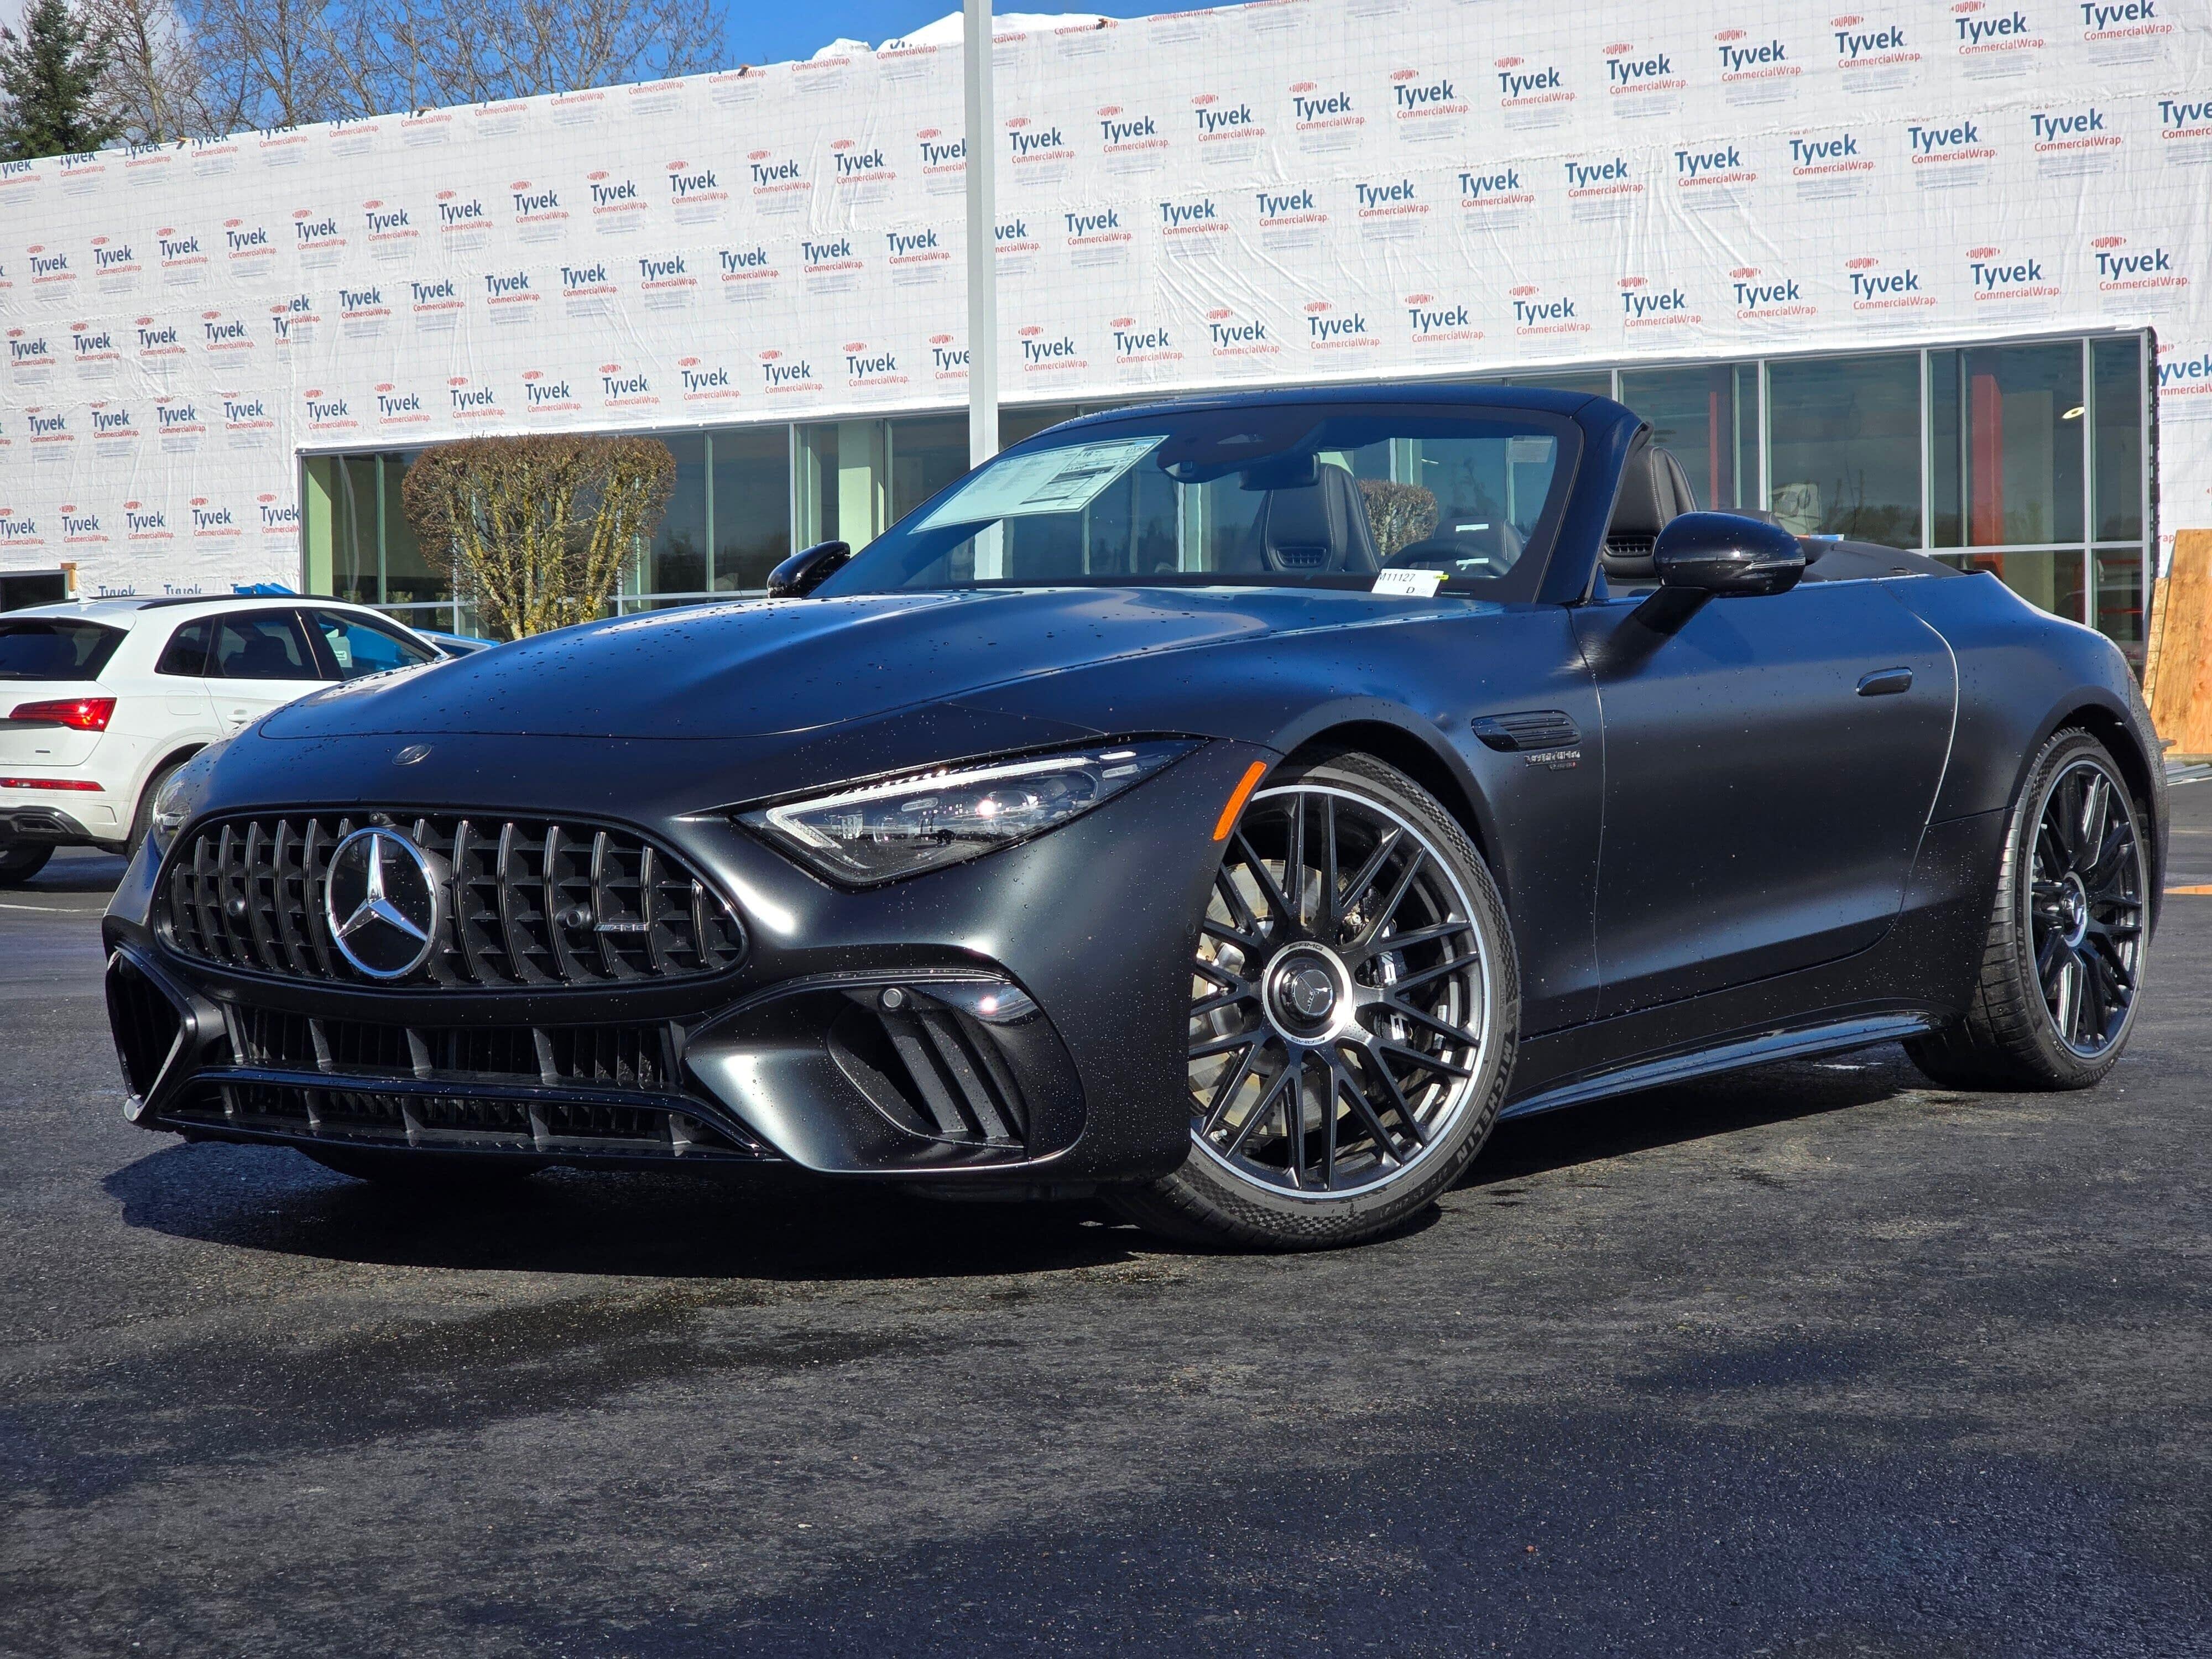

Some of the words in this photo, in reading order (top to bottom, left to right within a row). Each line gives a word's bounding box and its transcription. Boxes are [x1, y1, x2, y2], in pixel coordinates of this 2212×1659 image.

[2081, 0, 2154, 30] Tyvek
[1955, 12, 2026, 44] Tyvek
[1835, 26, 1903, 58] Tyvek
[1719, 40, 1785, 71] Tyvek
[1499, 67, 1560, 97] Tyvek
[1607, 54, 1670, 85] Tyvek
[1293, 92, 1350, 121] Tyvek
[1394, 80, 1453, 109] Tyvek
[1196, 104, 1251, 132] Tyvek
[2031, 108, 2103, 141] Tyvek
[2158, 101, 2212, 128] Tyve
[1010, 128, 1062, 154] Tyvek
[1101, 116, 1155, 143] Tyvek
[1908, 122, 1978, 153] Tyvek
[834, 150, 883, 174] Tyvek
[1675, 146, 1740, 176] Tyvek
[1790, 134, 1856, 165] Tyvek
[1, 160, 32, 179] yvek
[751, 160, 799, 185] Tyvek
[1565, 158, 1627, 187] Tyvek
[591, 181, 635, 205] Tyvek
[670, 171, 716, 196] Tyvek
[1356, 180, 1414, 207] Tyvek
[1459, 169, 1519, 198] Tyvek
[440, 201, 482, 223] Tyvek
[514, 191, 560, 215] Tyvek
[1160, 199, 1215, 226] Tyvek
[1256, 190, 1313, 217] Tyvek
[296, 218, 336, 241] Tyvek
[367, 210, 410, 232] Tyvek
[995, 220, 1026, 239] vek
[1065, 209, 1118, 236] Tyvek
[160, 237, 199, 258] Tyvek
[228, 228, 266, 249] Tyvek
[886, 229, 937, 255] Tyvek
[96, 248, 132, 267] Tyvek
[719, 247, 766, 272] Tyvek
[802, 239, 850, 264] Tyvek
[32, 256, 66, 274] Tyvek
[561, 264, 606, 288] Tyvek
[639, 256, 685, 280] Tyvek
[1971, 259, 2041, 290] Tyvek
[2096, 249, 2169, 280] Tyvek
[412, 280, 453, 303] Tyvek
[486, 272, 528, 296] Tyvek
[1734, 279, 1799, 309] Tyvek
[1850, 269, 1918, 300] Tyvek
[340, 289, 380, 310] Tyvek
[1514, 298, 1574, 325] Tyvek
[1622, 289, 1685, 317] Tyvek
[206, 321, 246, 341] Tyvek
[1308, 314, 1365, 340] Tyvek
[1409, 306, 1468, 333] Tyvek
[74, 335, 111, 352] Tyvek
[139, 330, 176, 347] Tyvek
[1114, 328, 1168, 354] Tyvek
[1210, 321, 1265, 347] Tyvek
[11, 341, 46, 358] Tyvek
[933, 348, 969, 369] Tyve
[1023, 337, 1074, 363] Tyvek
[763, 361, 810, 385] Tyvek
[847, 353, 895, 378] Tyvek
[2158, 354, 2212, 387] yvek
[603, 374, 647, 398] Tyvek
[682, 368, 728, 392] Tyvek
[379, 394, 419, 416] Tyvek
[452, 387, 493, 410] Tyvek
[526, 384, 569, 404] Tyvek
[93, 411, 129, 430] Tyvek
[157, 405, 195, 425] Tyvek
[225, 400, 263, 421] Tyvek
[307, 399, 347, 421] Tyvek
[28, 416, 65, 434] Tyvek
[64, 517, 98, 534] Tyvek
[128, 513, 164, 531] Tyvek
[193, 509, 231, 528] Tyvek
[261, 506, 299, 524] Tyvek
[1297, 942, 1323, 951] AMG
[1457, 1041, 1513, 1164] MICHELIN
